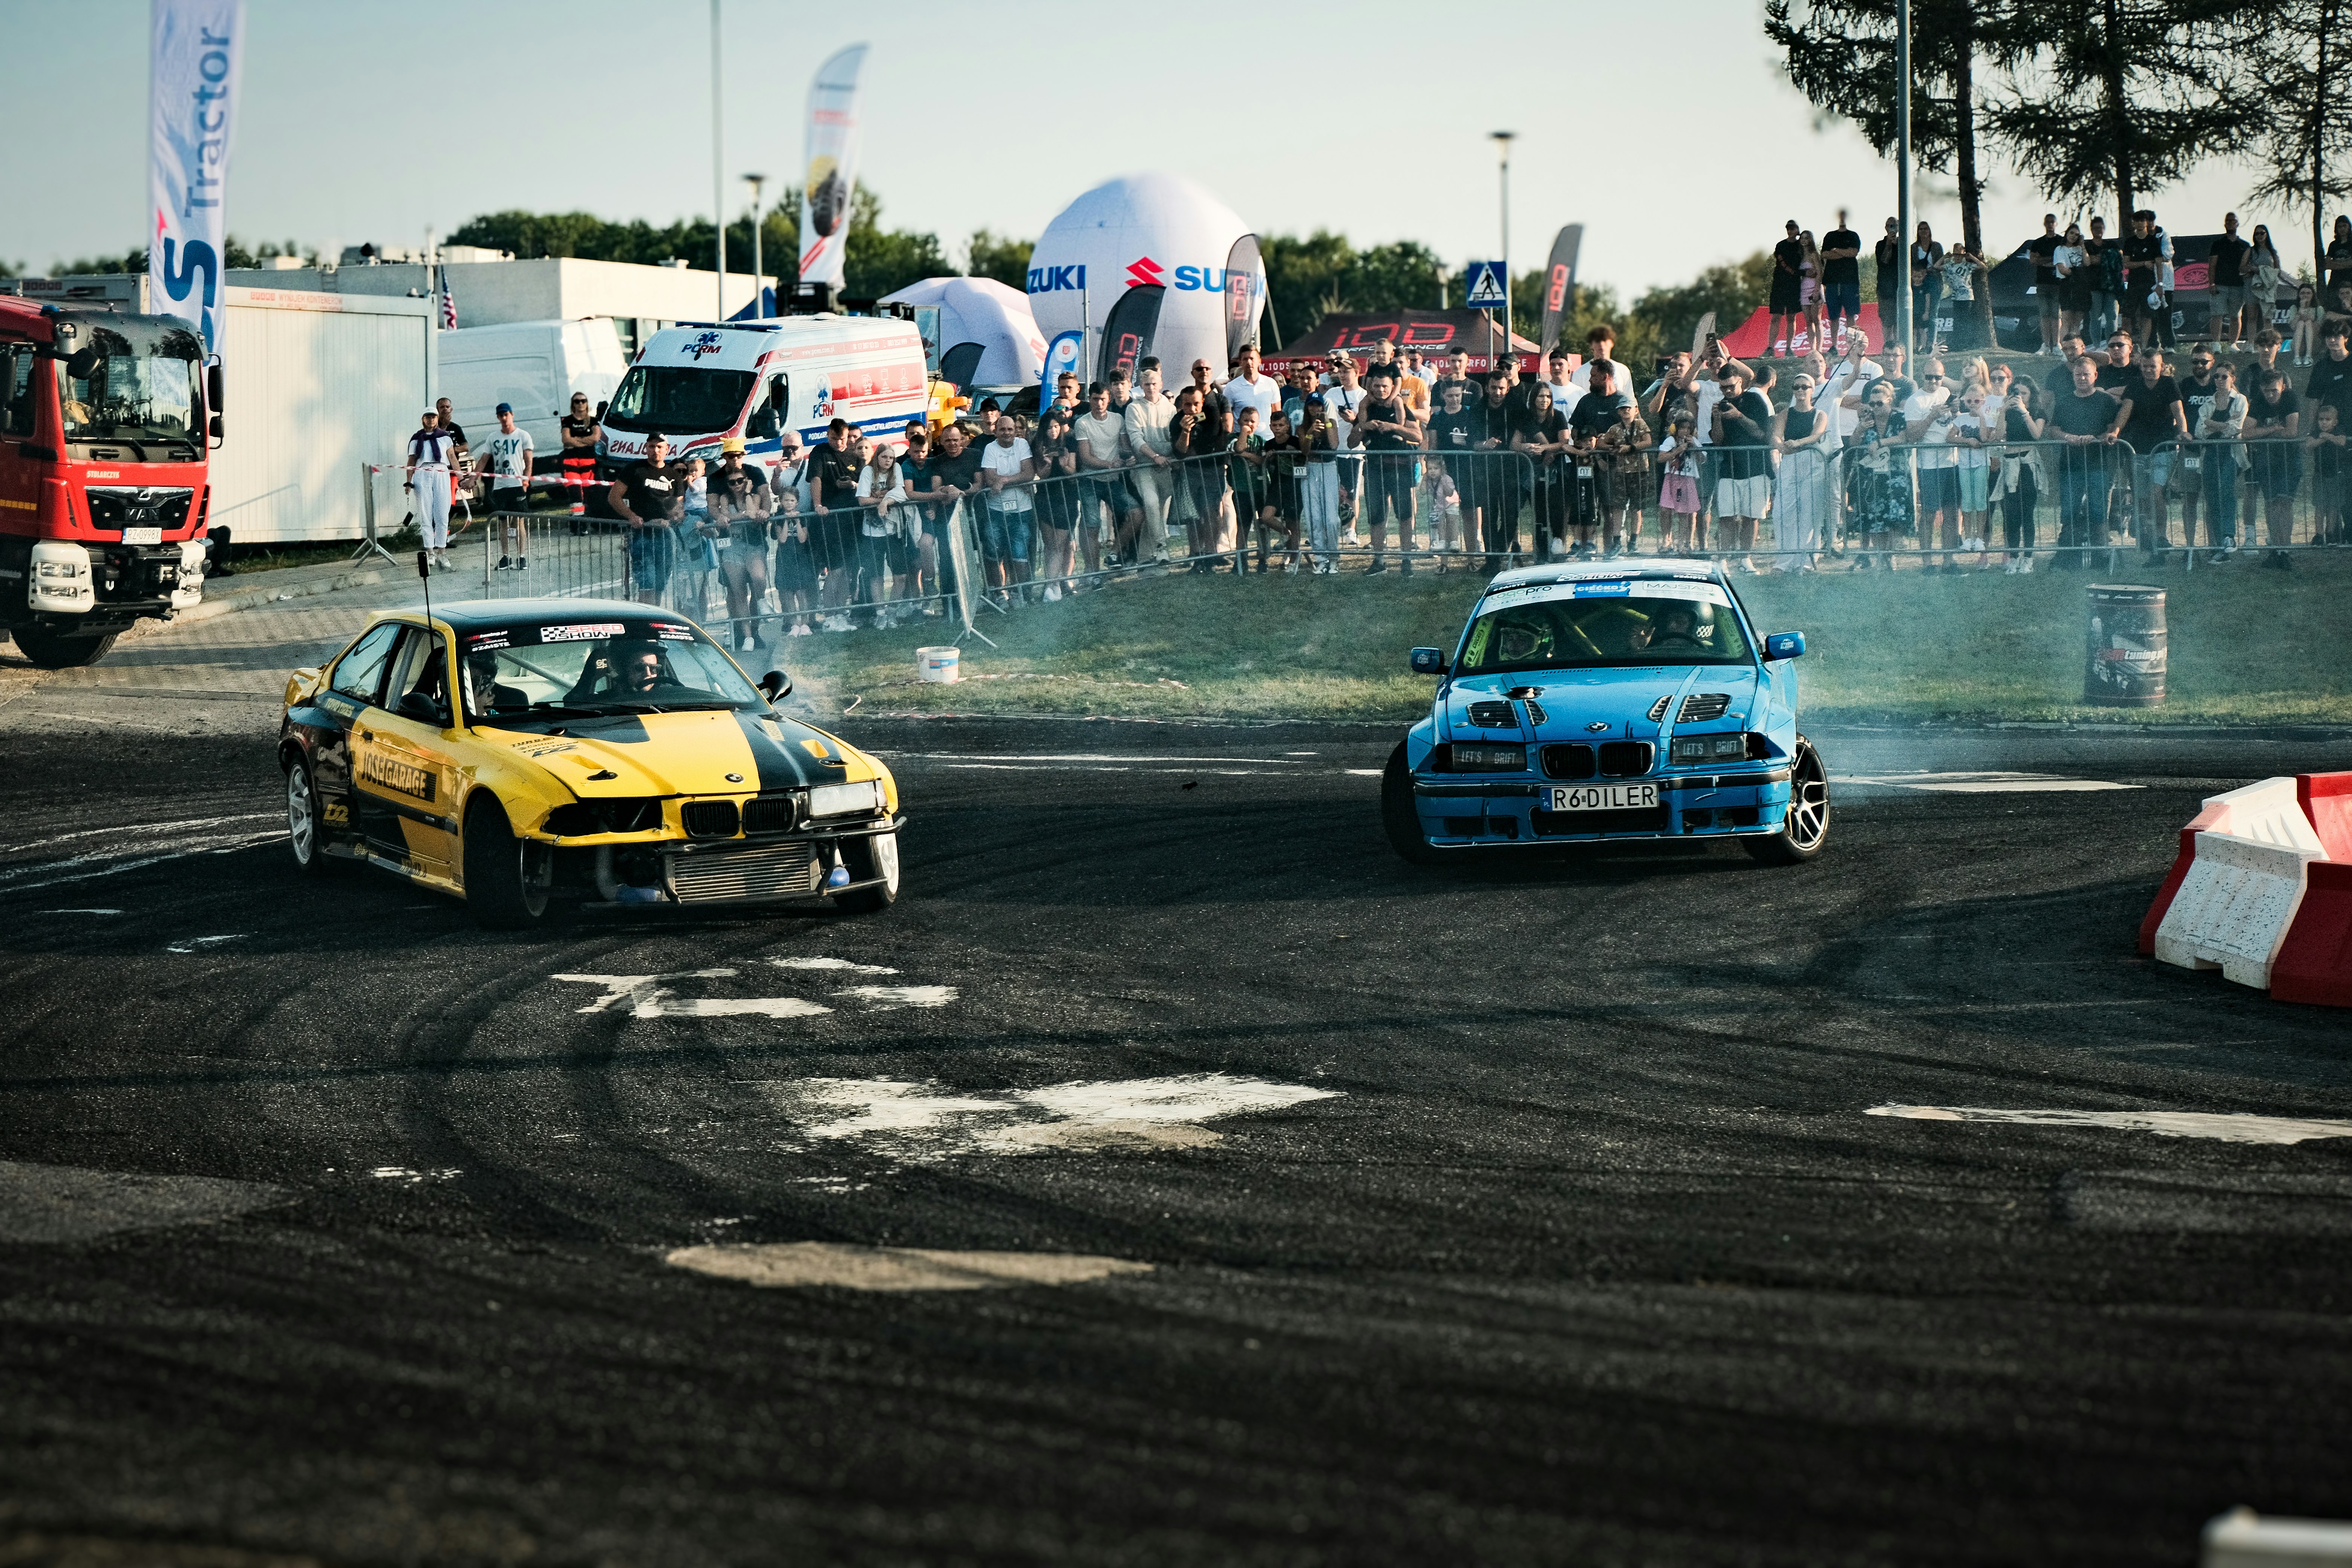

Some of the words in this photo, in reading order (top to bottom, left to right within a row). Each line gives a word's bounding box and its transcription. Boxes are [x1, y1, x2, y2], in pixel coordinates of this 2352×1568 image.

[185, 27, 230, 217] Tractor
[1026, 265, 1086, 295] ZUKI
[681, 344, 722, 354] PCRM
[1132, 337, 1144, 387] PERFORMANCE
[813, 403, 835, 419] PCRM
[493, 439, 519, 456] SAY
[645, 478, 669, 491] PUMA
[125, 509, 160, 521] MAN
[128, 529, 137, 539] RZ
[139, 529, 160, 539] 0998X
[567, 624, 623, 633] SPEED
[472, 642, 510, 652] #ZAISTE
[1716, 741, 1738, 753] DRIFT
[1494, 752, 1516, 764] DRIFT
[361, 750, 384, 786] JOSE
[385, 761, 427, 798] GARAGE
[1554, 789, 1581, 809] R6
[1587, 785, 1654, 808] DILER
